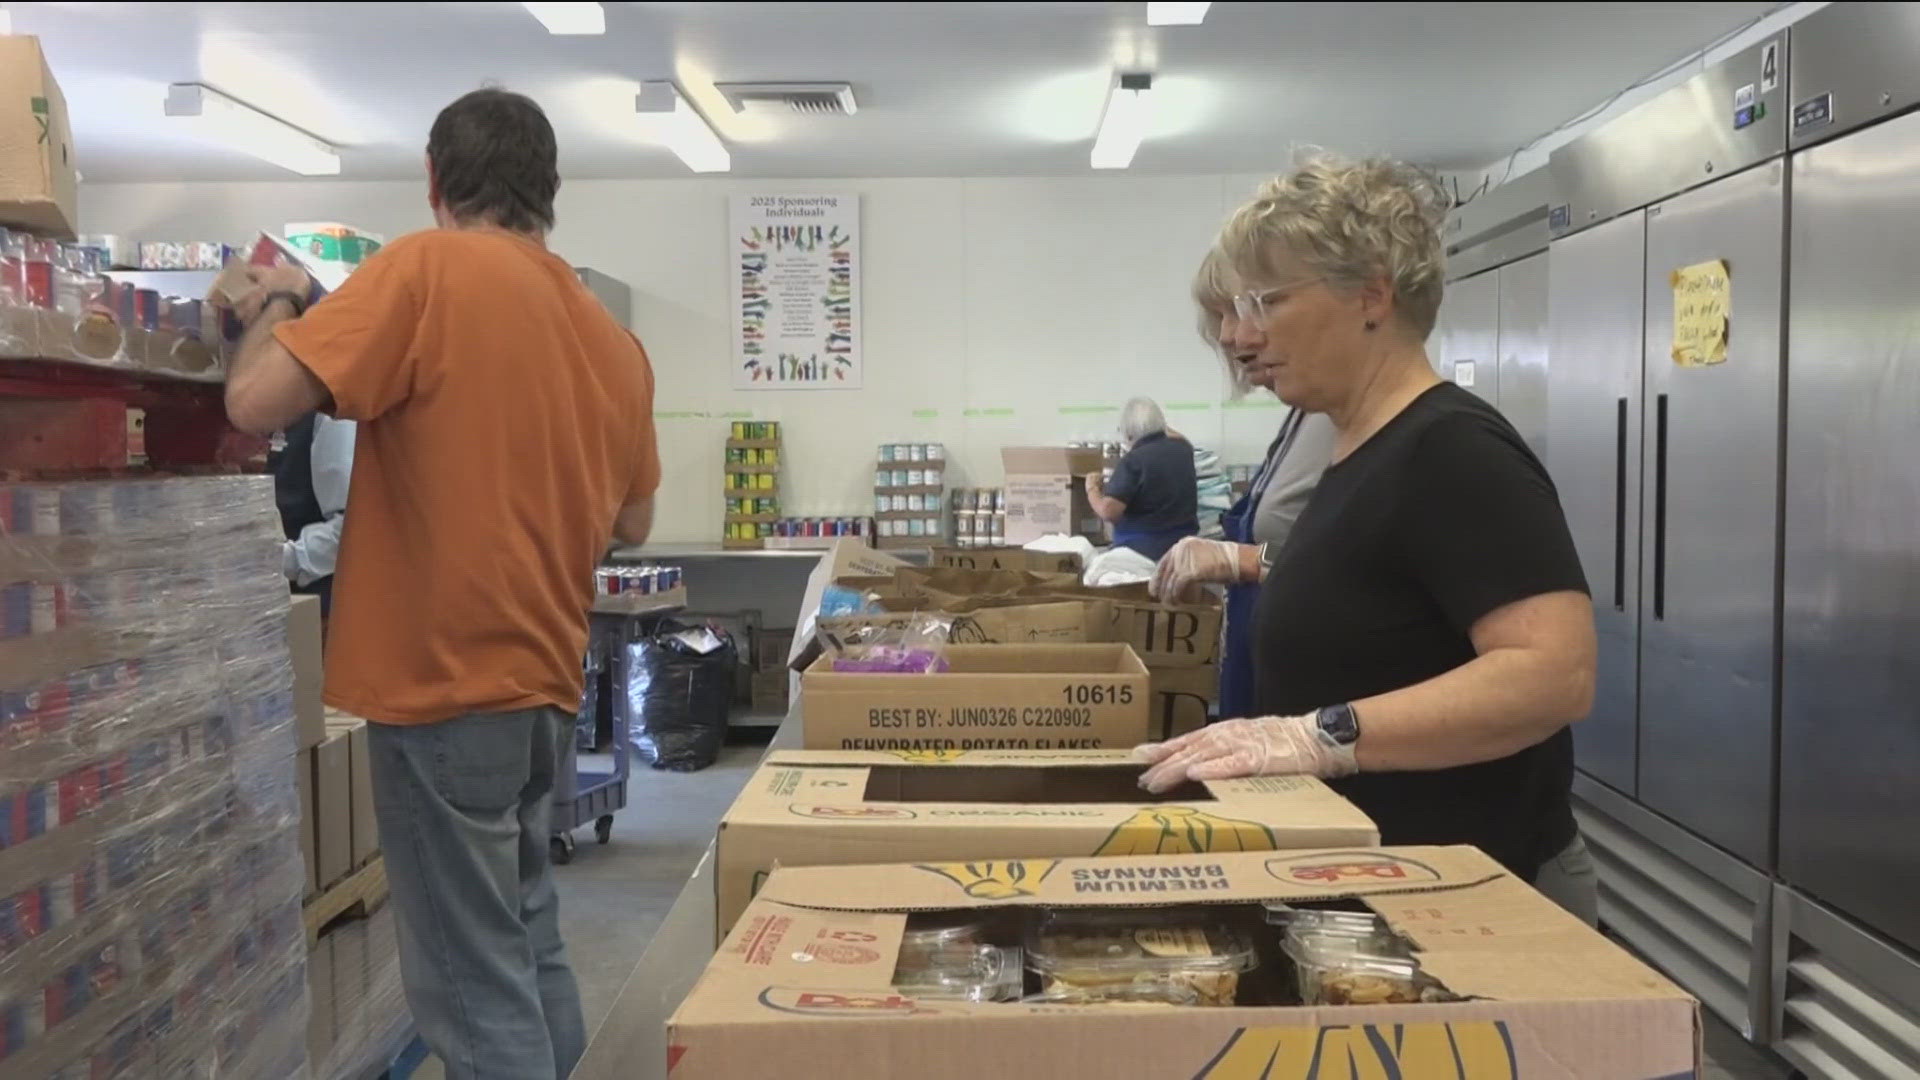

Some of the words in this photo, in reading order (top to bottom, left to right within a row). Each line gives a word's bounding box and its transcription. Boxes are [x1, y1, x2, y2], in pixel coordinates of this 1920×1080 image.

[1763, 45, 1776, 87] 4
[778, 195, 838, 209] Sponsoring
[765, 207, 825, 218] Individuals
[1062, 684, 1133, 705] 10615
[869, 708, 912, 728] BEST
[916, 708, 942, 728] BY:
[947, 707, 1018, 727] JUN0326
[1022, 706, 1092, 727] C220902
[1071, 864, 1225, 880] BANANAS
[1289, 862, 1406, 882] Dole
[1074, 878, 1230, 893] PREMIUM
